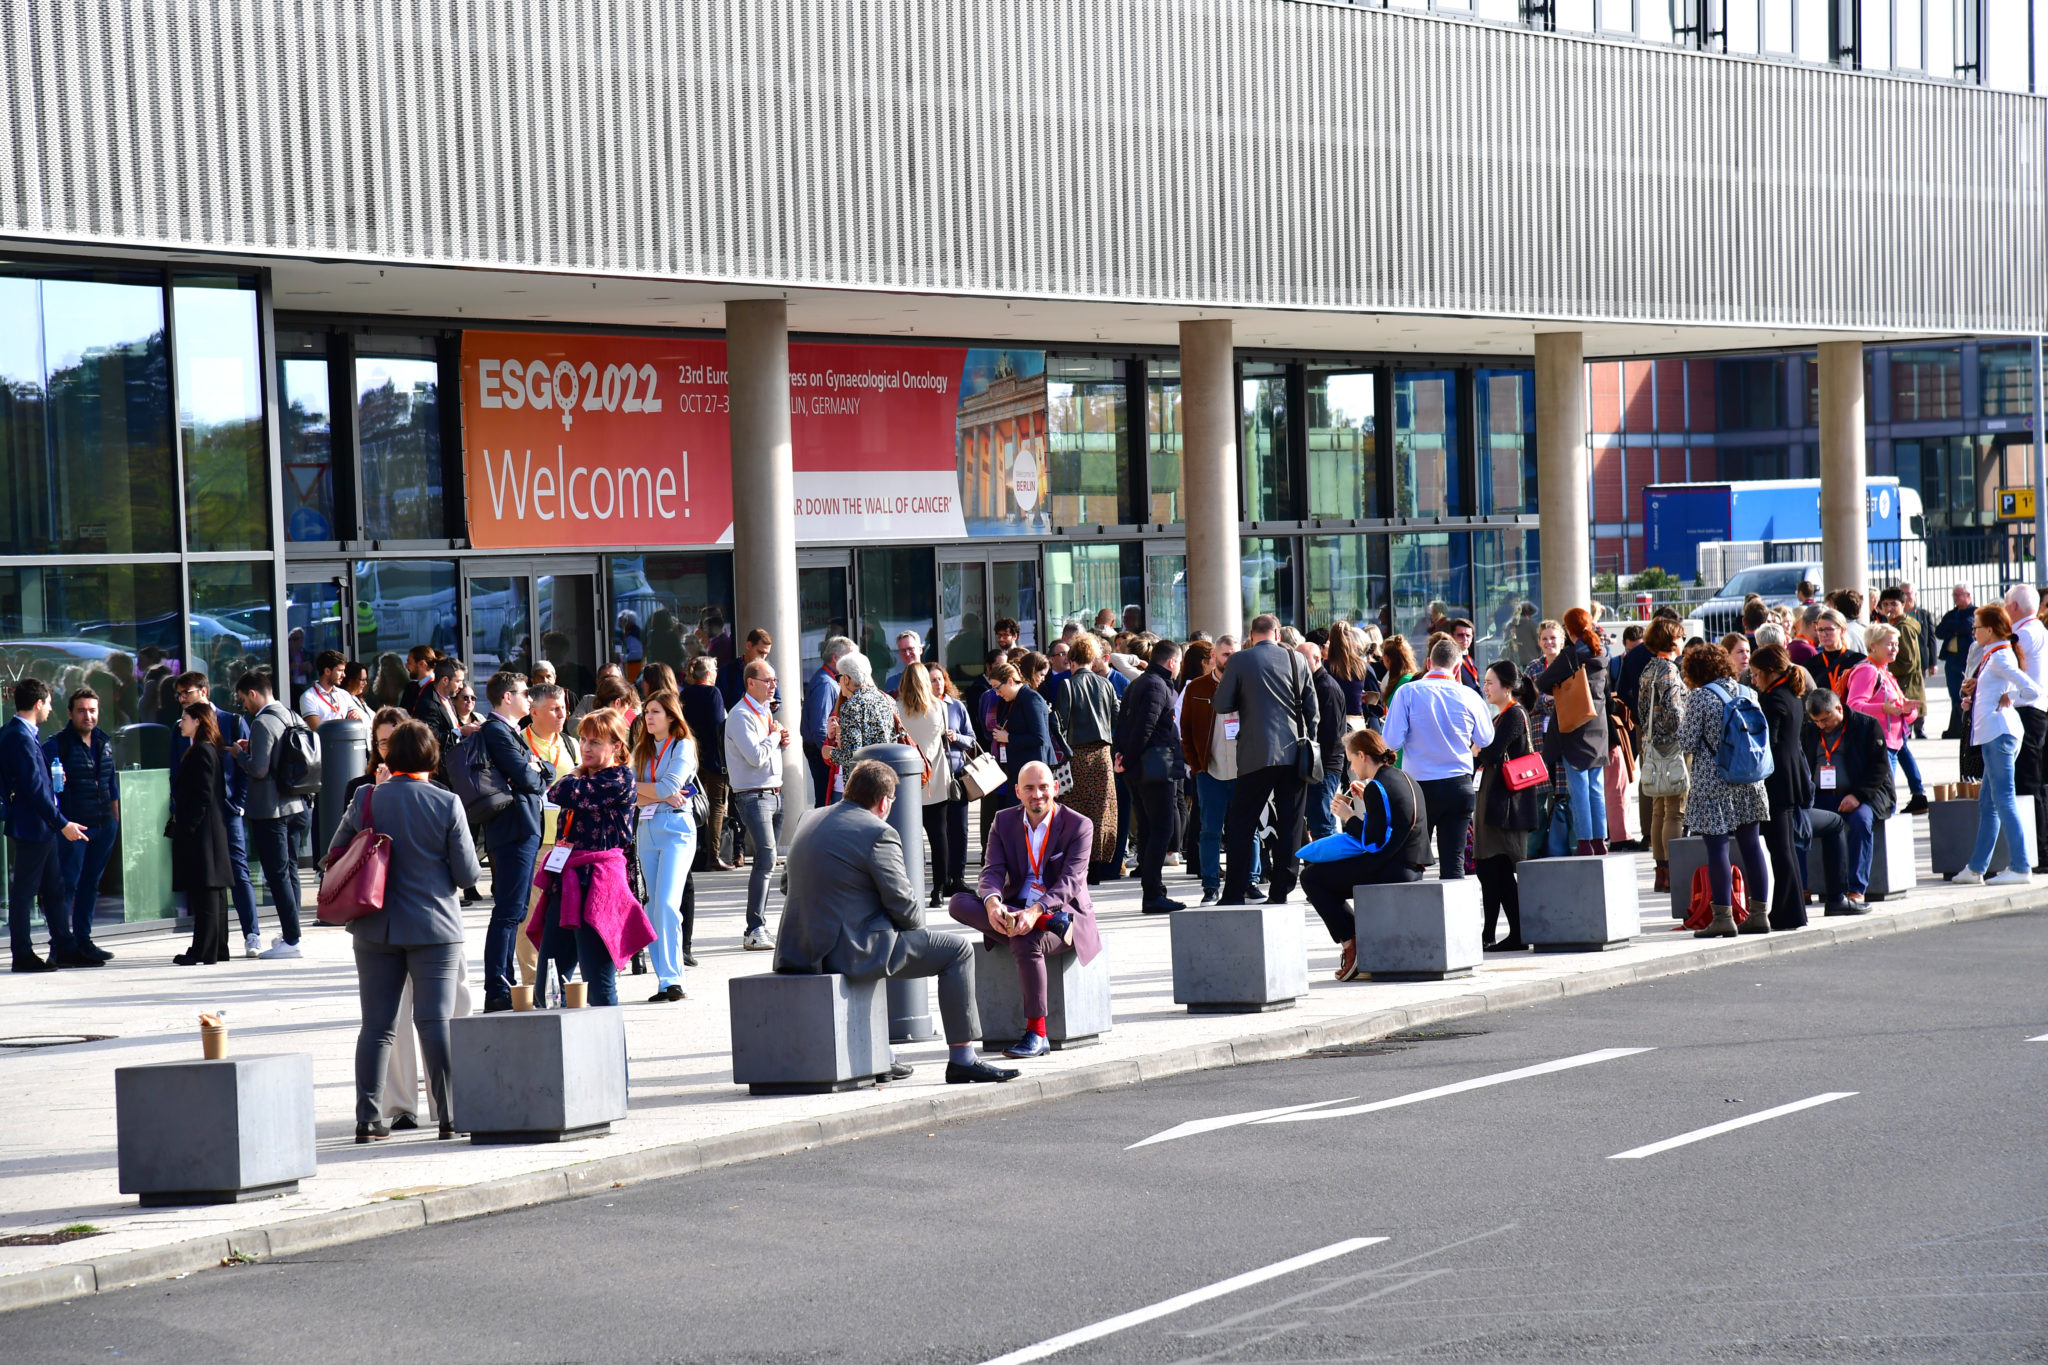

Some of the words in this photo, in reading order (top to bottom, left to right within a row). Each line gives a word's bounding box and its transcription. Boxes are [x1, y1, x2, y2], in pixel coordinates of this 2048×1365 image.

[679, 365, 703, 384] 23rd
[809, 373, 823, 387] on
[825, 369, 900, 392] Gynaecological
[902, 371, 948, 394] Oncology
[680, 393, 702, 413] OCT
[811, 396, 860, 414] GERMANY
[483, 445, 690, 520] Welcome!
[1016, 480, 1036, 491] BERLIN
[805, 498, 840, 515] DOWN
[842, 498, 862, 515] THE
[864, 498, 893, 514] WALL
[895, 497, 908, 513] OF
